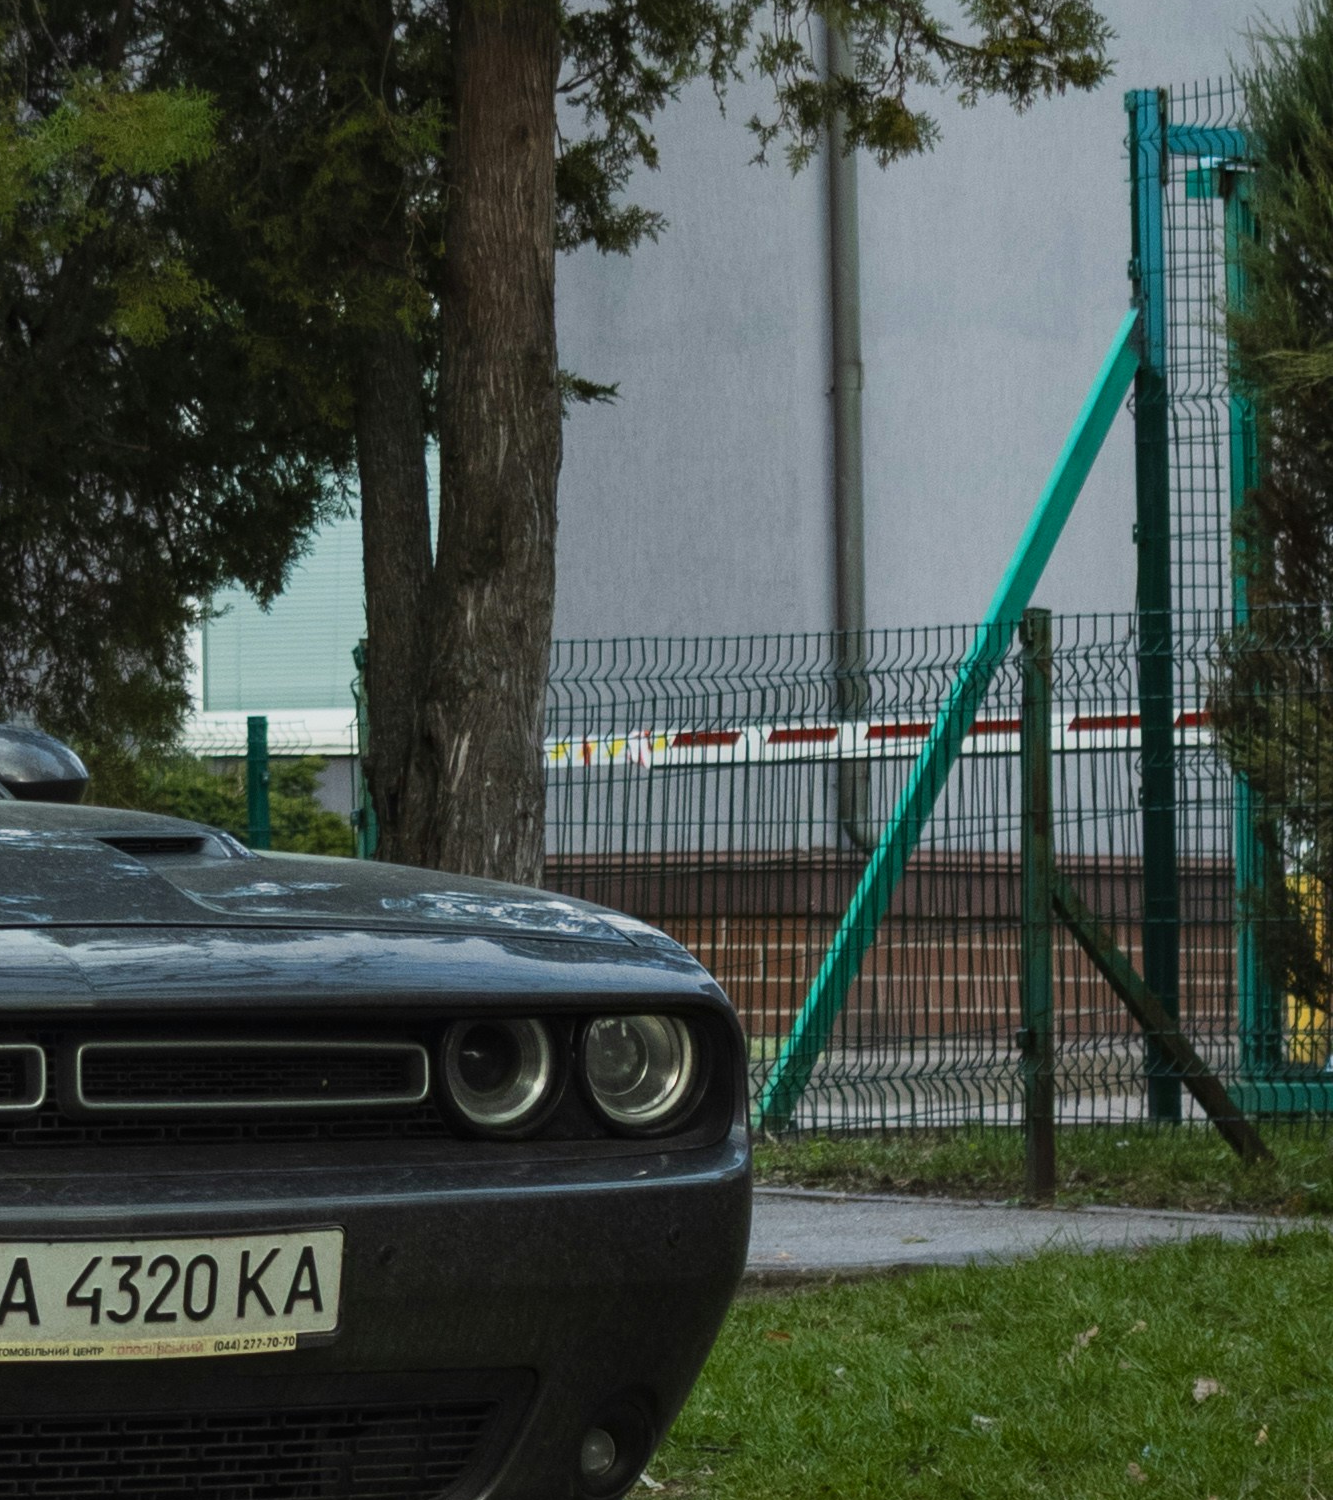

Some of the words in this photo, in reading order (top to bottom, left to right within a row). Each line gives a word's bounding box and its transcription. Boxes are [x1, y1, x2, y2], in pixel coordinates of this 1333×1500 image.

[66, 1254, 219, 1325] 4320
[236, 1245, 324, 1319] KA
[73, 1345, 105, 1357] ЦЕНТР
[214, 1340, 241, 1352] (044)
[243, 1335, 296, 1350] 277-70-70
